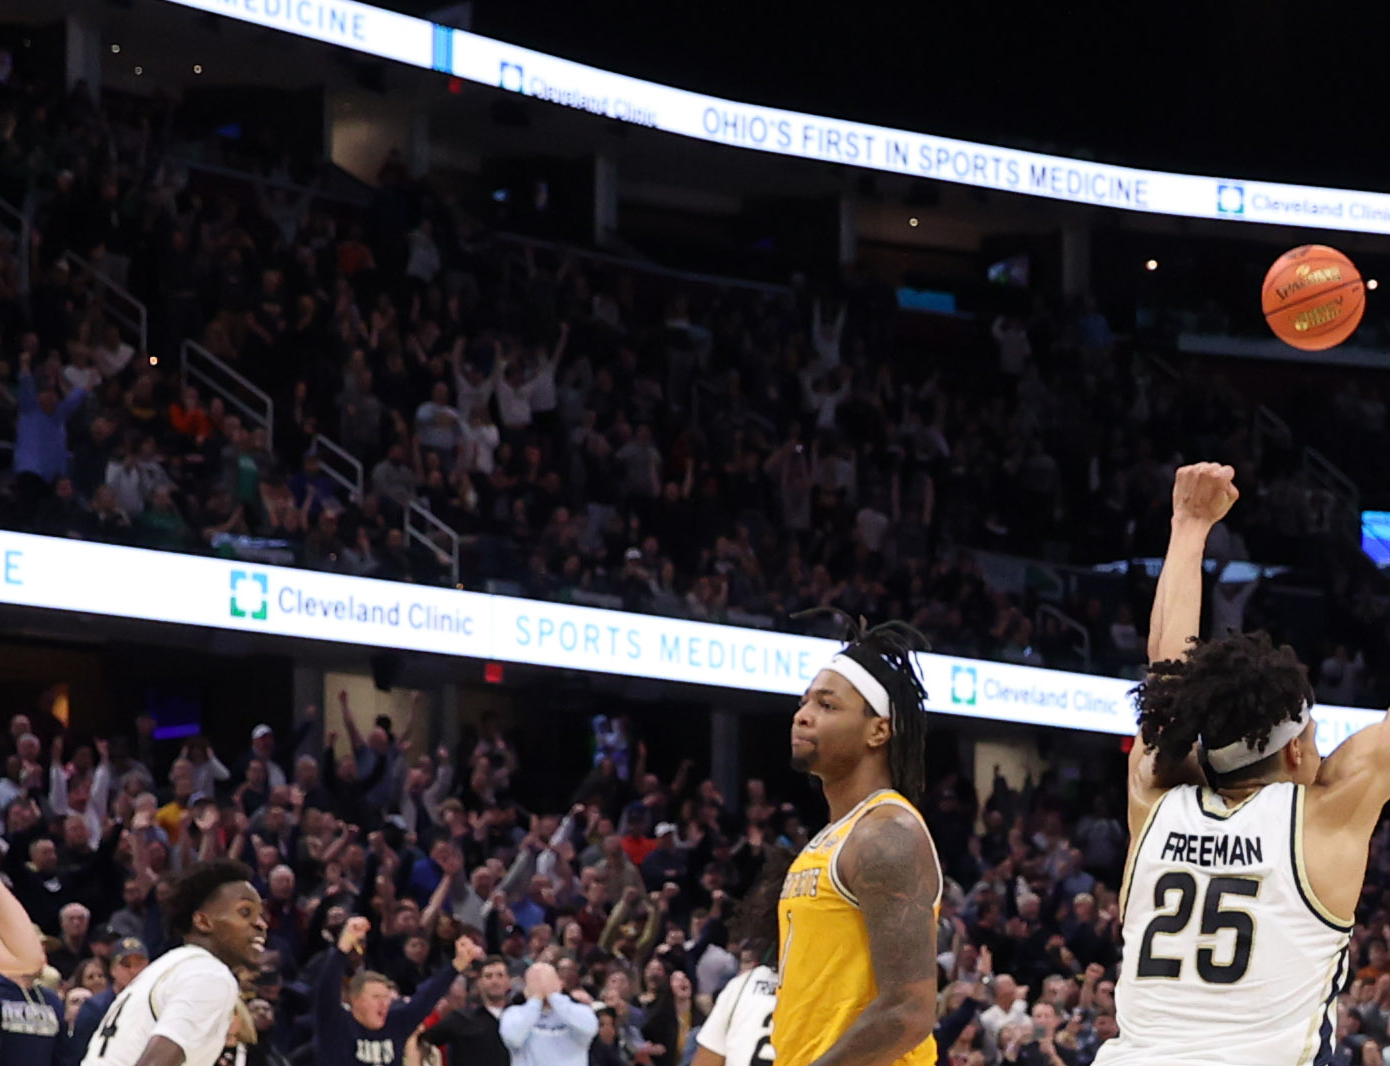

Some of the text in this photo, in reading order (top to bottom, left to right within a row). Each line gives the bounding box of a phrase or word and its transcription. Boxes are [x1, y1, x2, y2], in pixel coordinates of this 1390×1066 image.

[703, 107, 1149, 205] OHIO'S FIRST IN SPORTS MEDICINE
[1251, 194, 1344, 220] Cleveland
[278, 586, 812, 680] Cleveland Clinic SPORTS MEDICINE
[983, 678, 1119, 714] Cleveland Clinic
[1161, 832, 1263, 866] FREEMAN
[1136, 870, 1263, 984] 25
